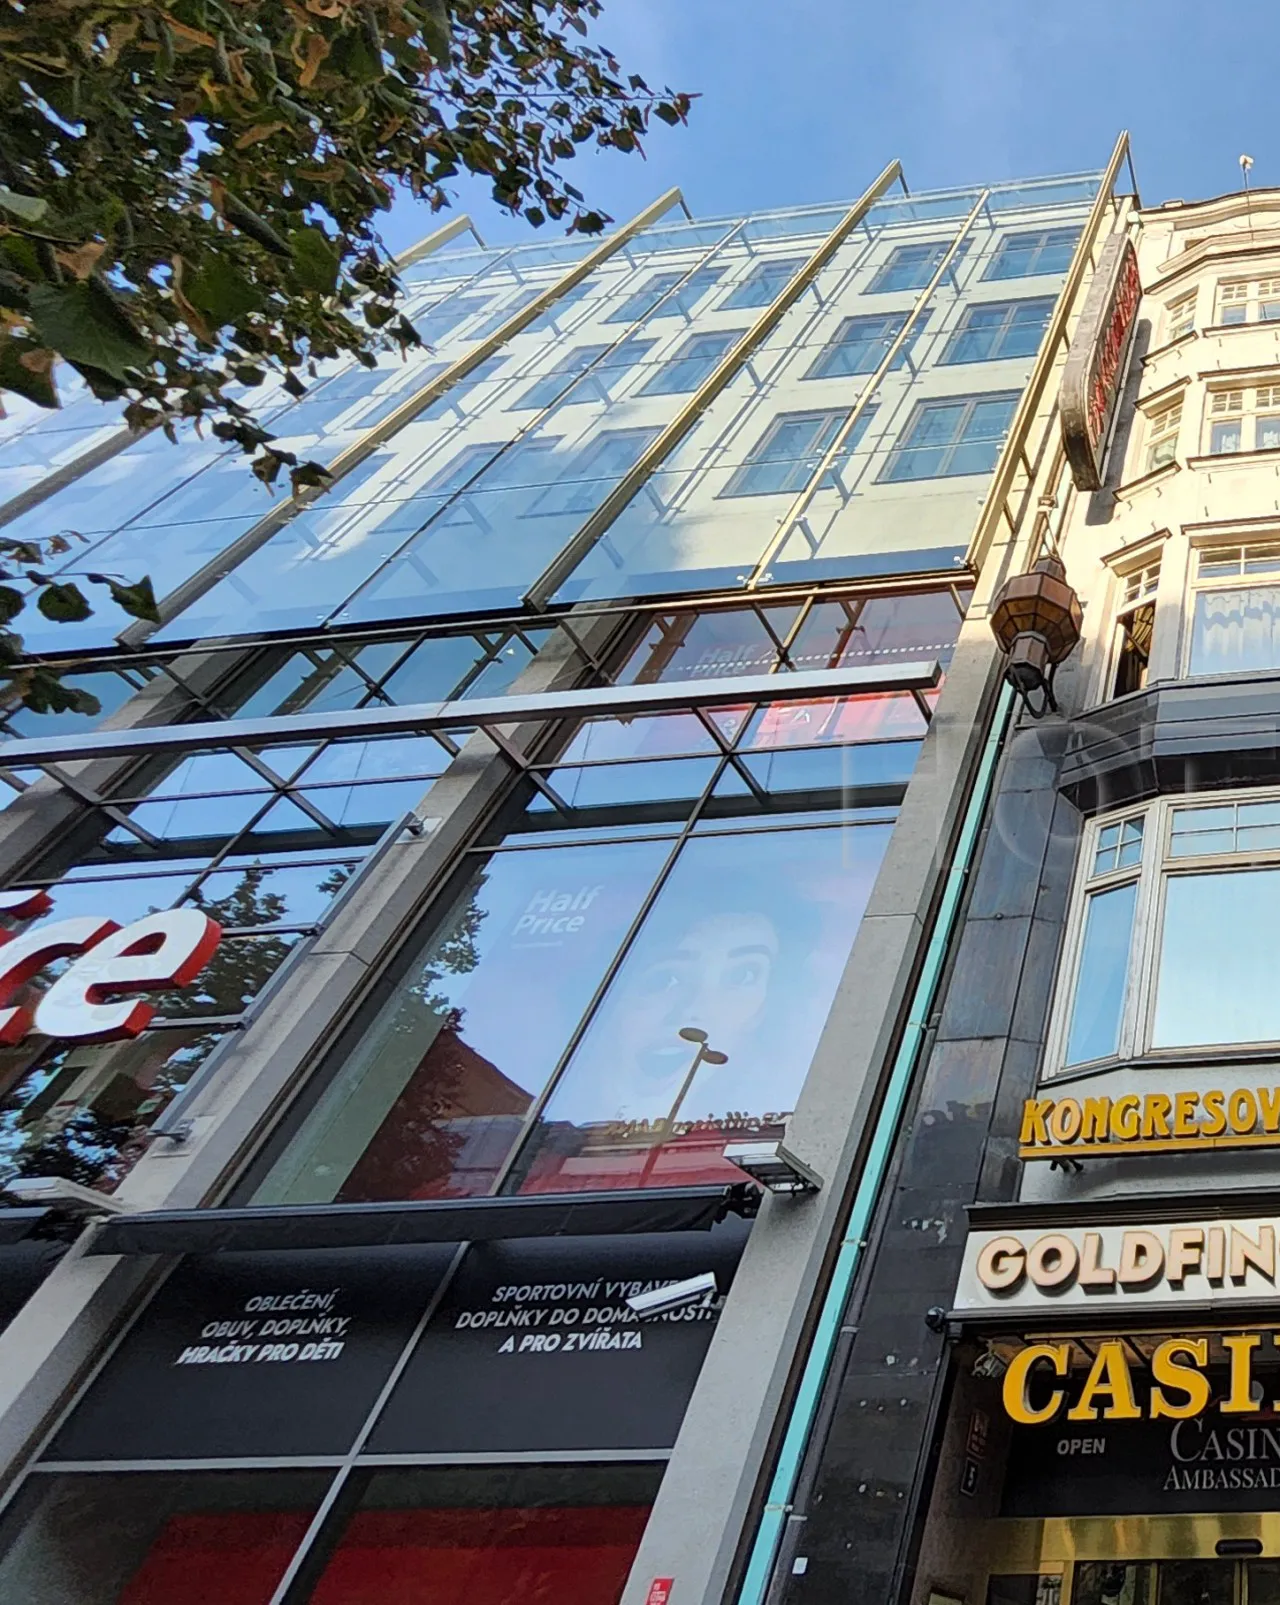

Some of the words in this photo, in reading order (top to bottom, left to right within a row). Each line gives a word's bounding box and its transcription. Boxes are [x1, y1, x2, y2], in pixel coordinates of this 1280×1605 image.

[526, 886, 604, 913] Half
[512, 915, 585, 936] Price
[0, 889, 223, 1046] ce
[245, 1288, 341, 1312] OBLEČENÍ,
[492, 1277, 604, 1303] SPORTOVNÍ
[201, 1320, 258, 1339] OBUV,
[258, 1313, 352, 1338] DOPLŇKY,
[455, 1305, 547, 1329] DOPLŇKY
[548, 1308, 577, 1326] DO
[175, 1340, 260, 1365] HRAČKY
[254, 1345, 299, 1363] PRO
[297, 1338, 345, 1361] DĚTI
[498, 1334, 514, 1353] A
[519, 1333, 558, 1352] PRO
[562, 1327, 643, 1350] ZVÍŘATA
[1057, 1438, 1106, 1456] OPEN
